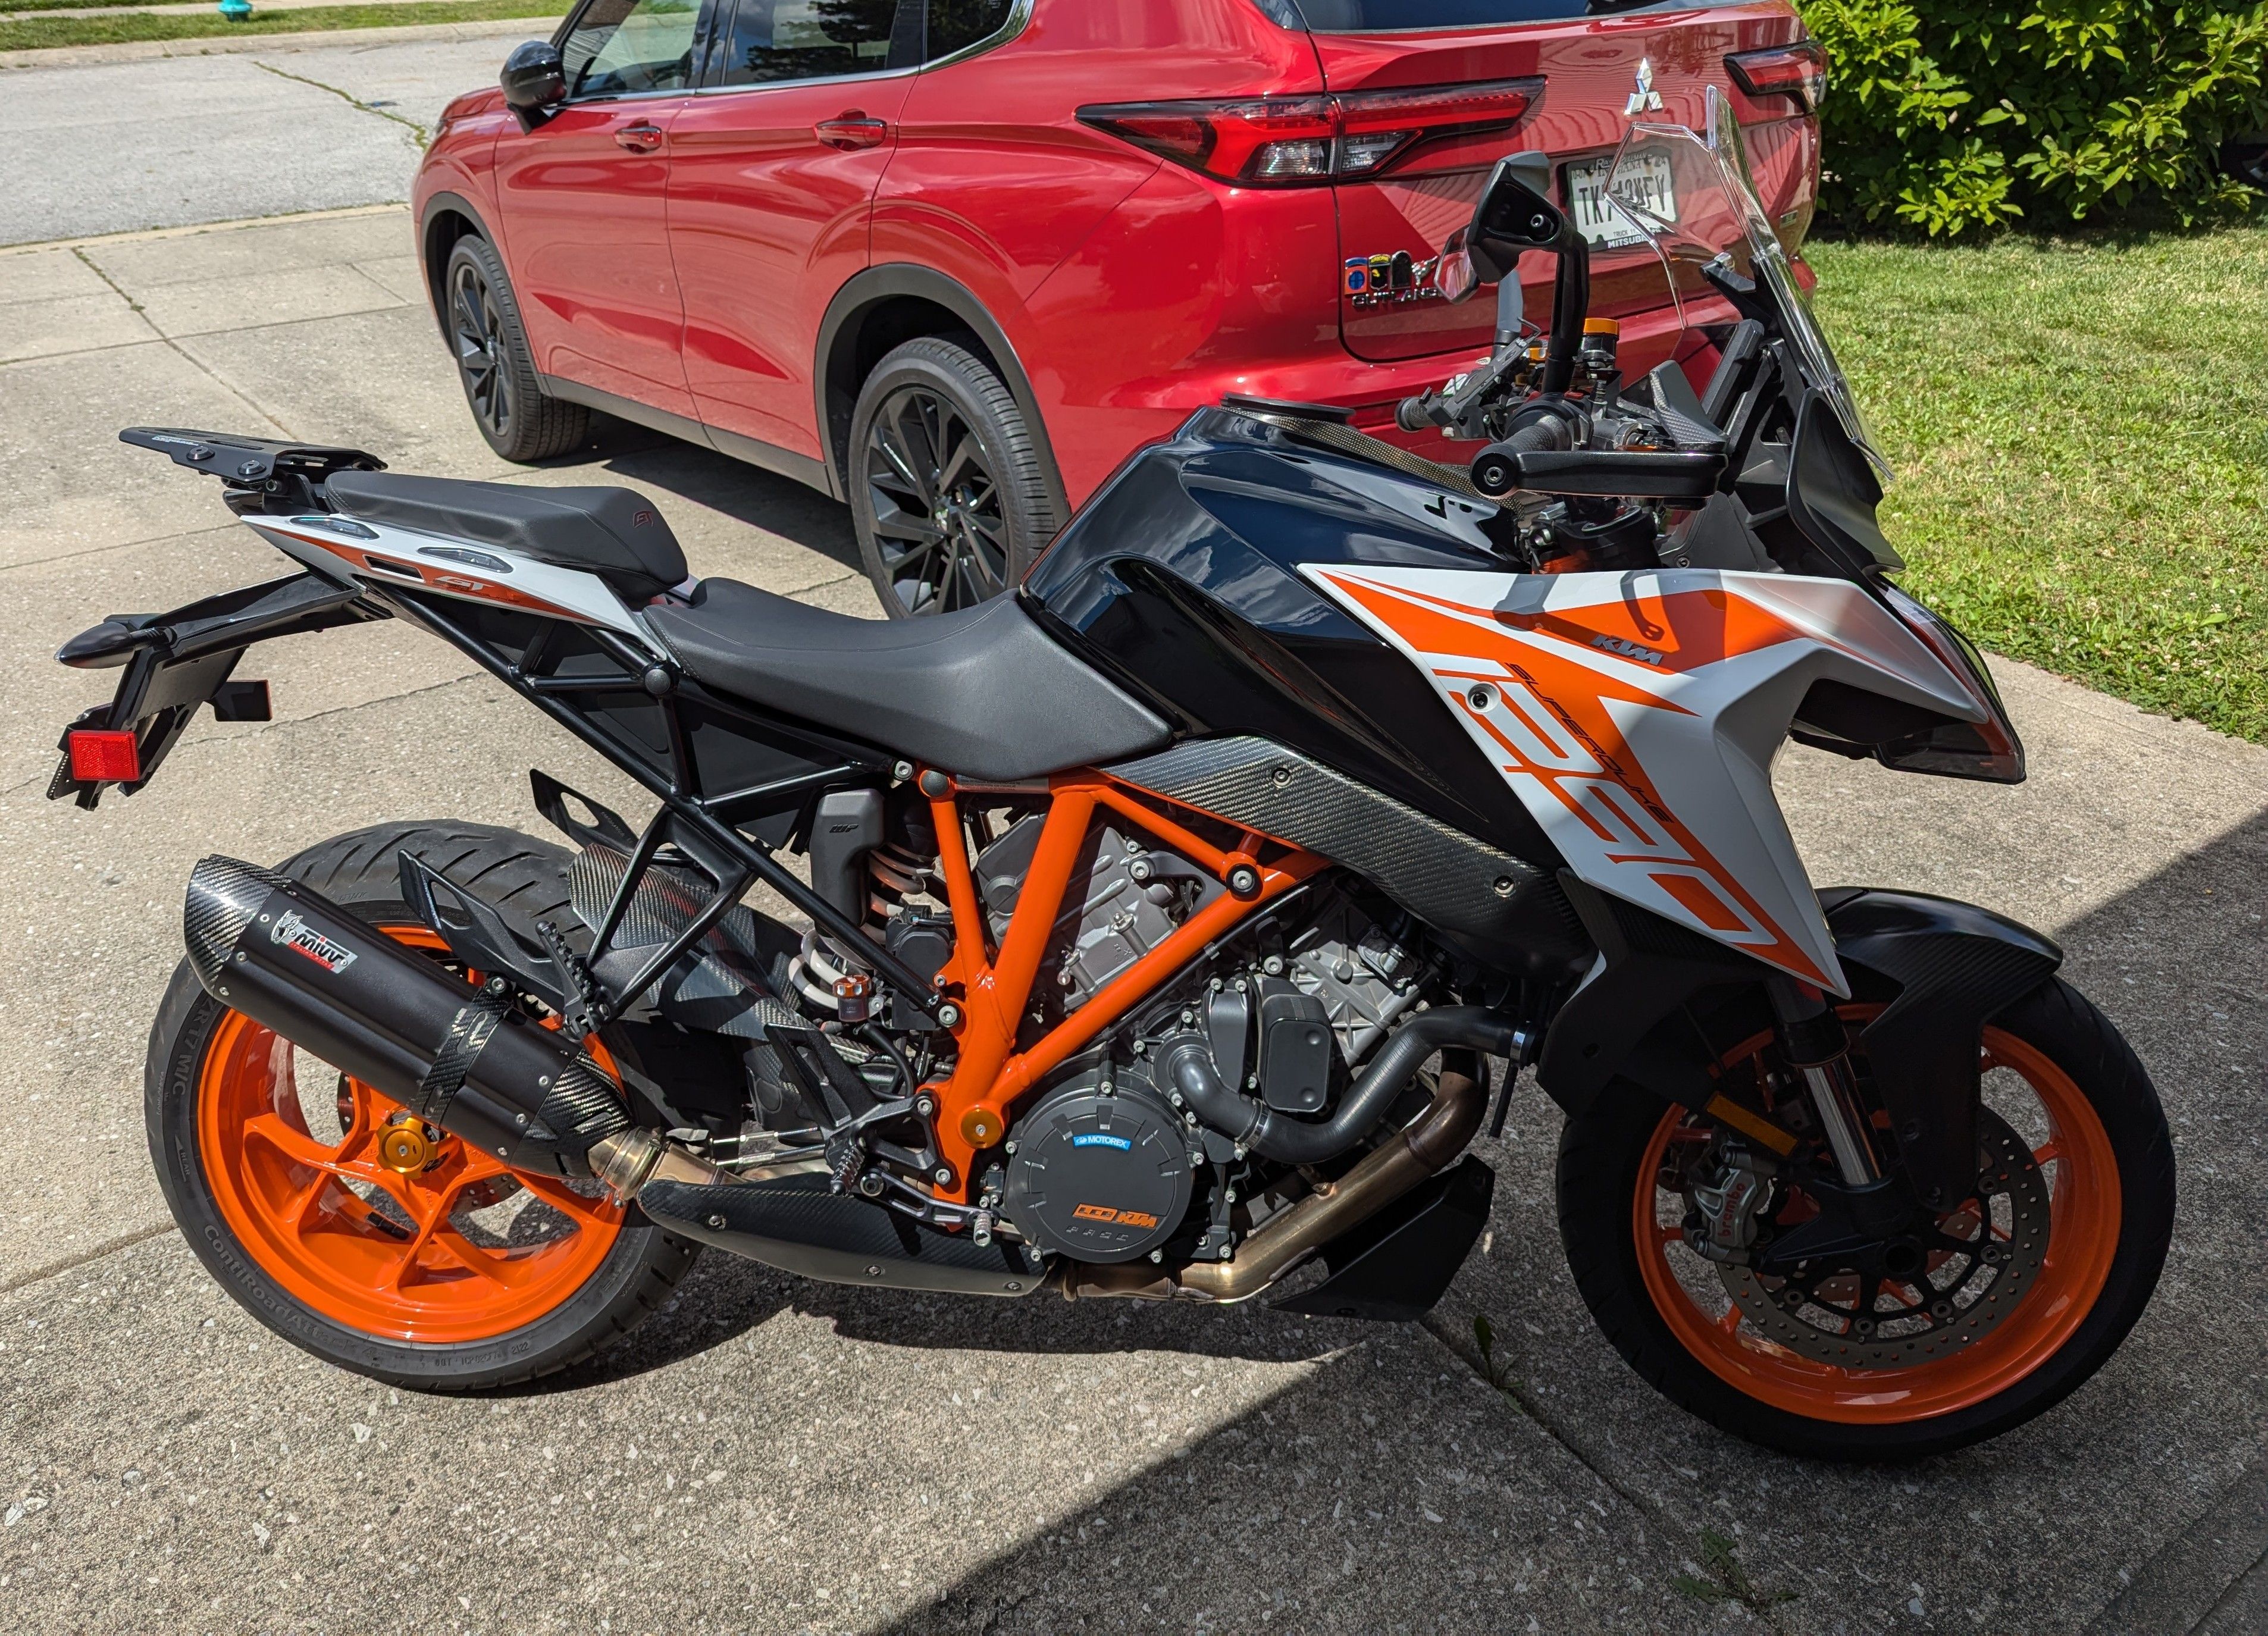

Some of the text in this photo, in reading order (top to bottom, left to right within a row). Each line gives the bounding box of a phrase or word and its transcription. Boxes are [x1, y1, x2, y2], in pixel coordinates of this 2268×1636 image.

[1590, 634, 1663, 666] KTM
[829, 823, 859, 833] WP
[1088, 1135, 1127, 1148] MOTOREX
[180, 1151, 190, 1177] REAR
[1116, 1211, 1158, 1229] KTM
[1717, 1183, 1747, 1236] brembo
